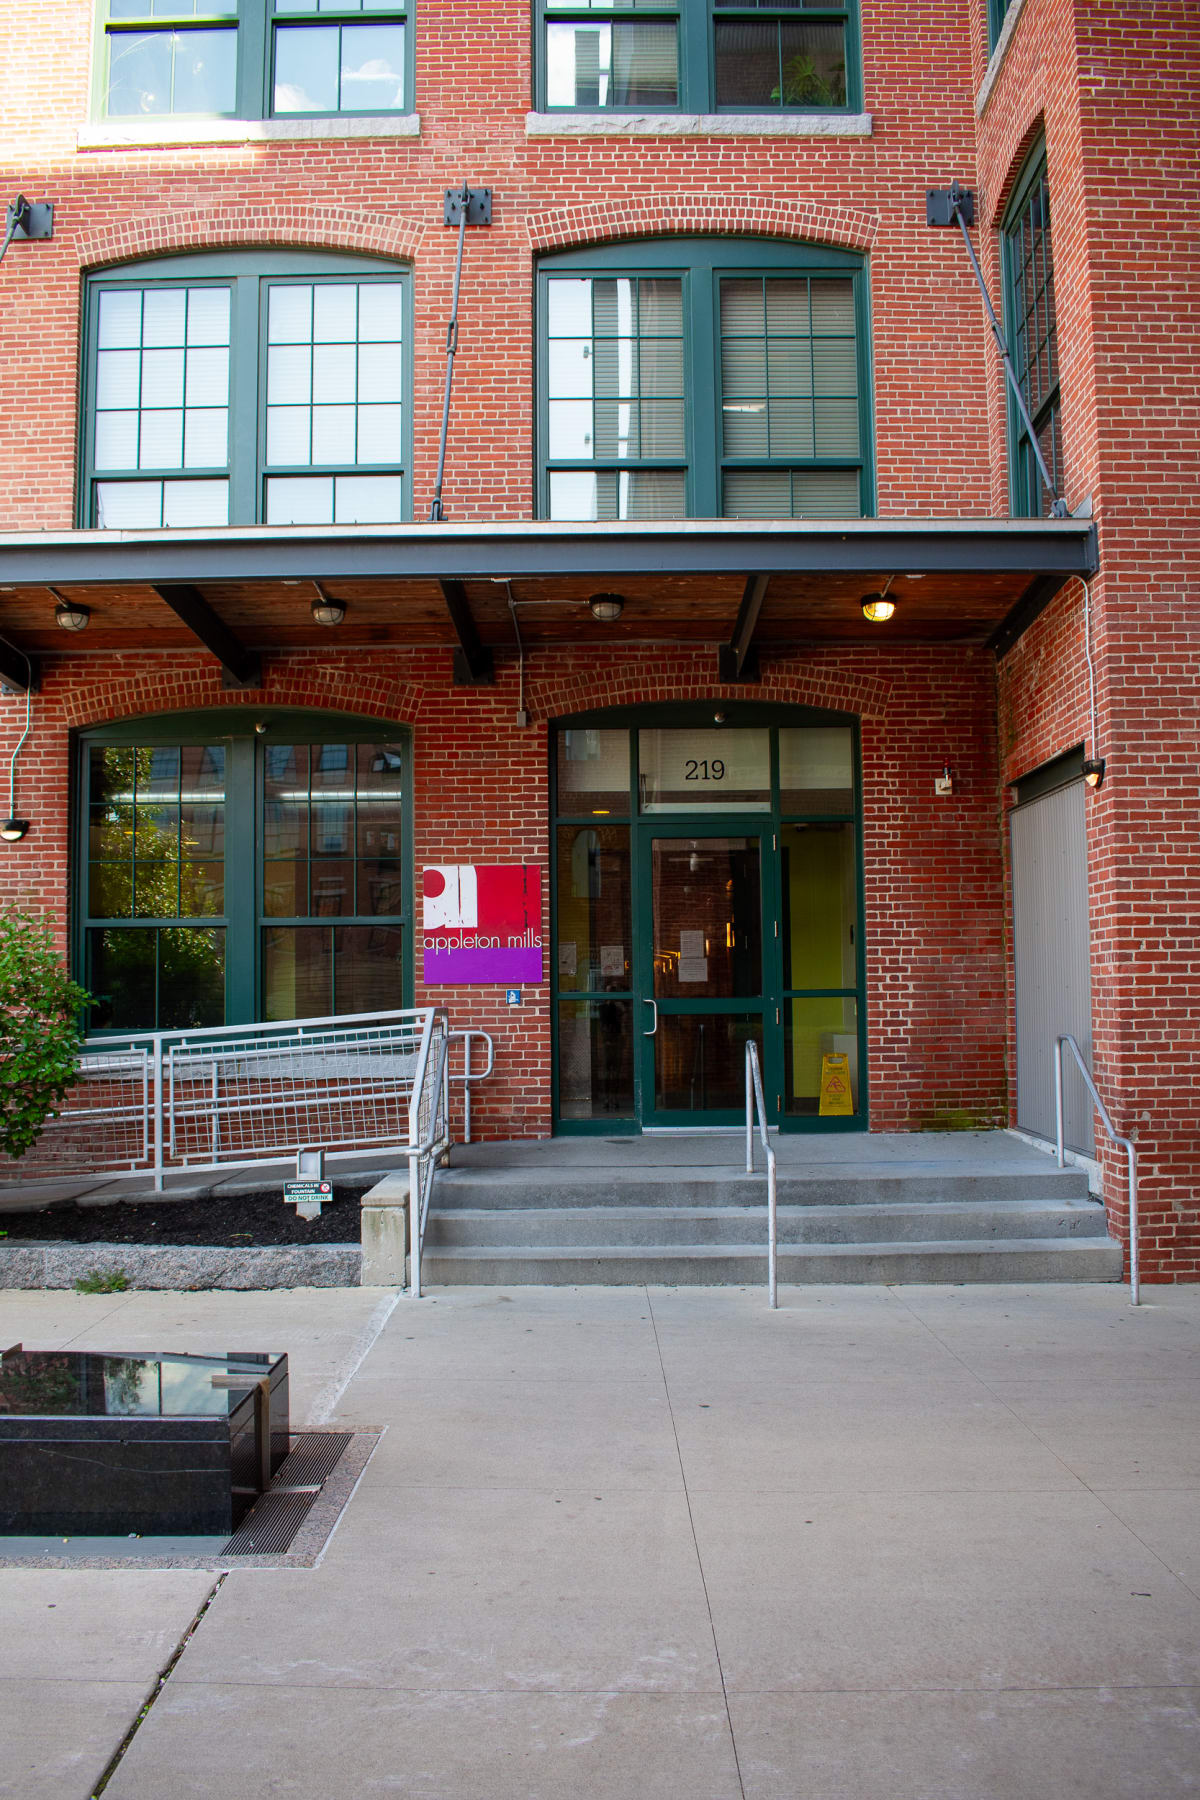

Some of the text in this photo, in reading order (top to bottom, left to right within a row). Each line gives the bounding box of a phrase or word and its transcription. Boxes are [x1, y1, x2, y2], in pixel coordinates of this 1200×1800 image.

[685, 760, 725, 780] 219
[424, 927, 542, 956] appleton mills
